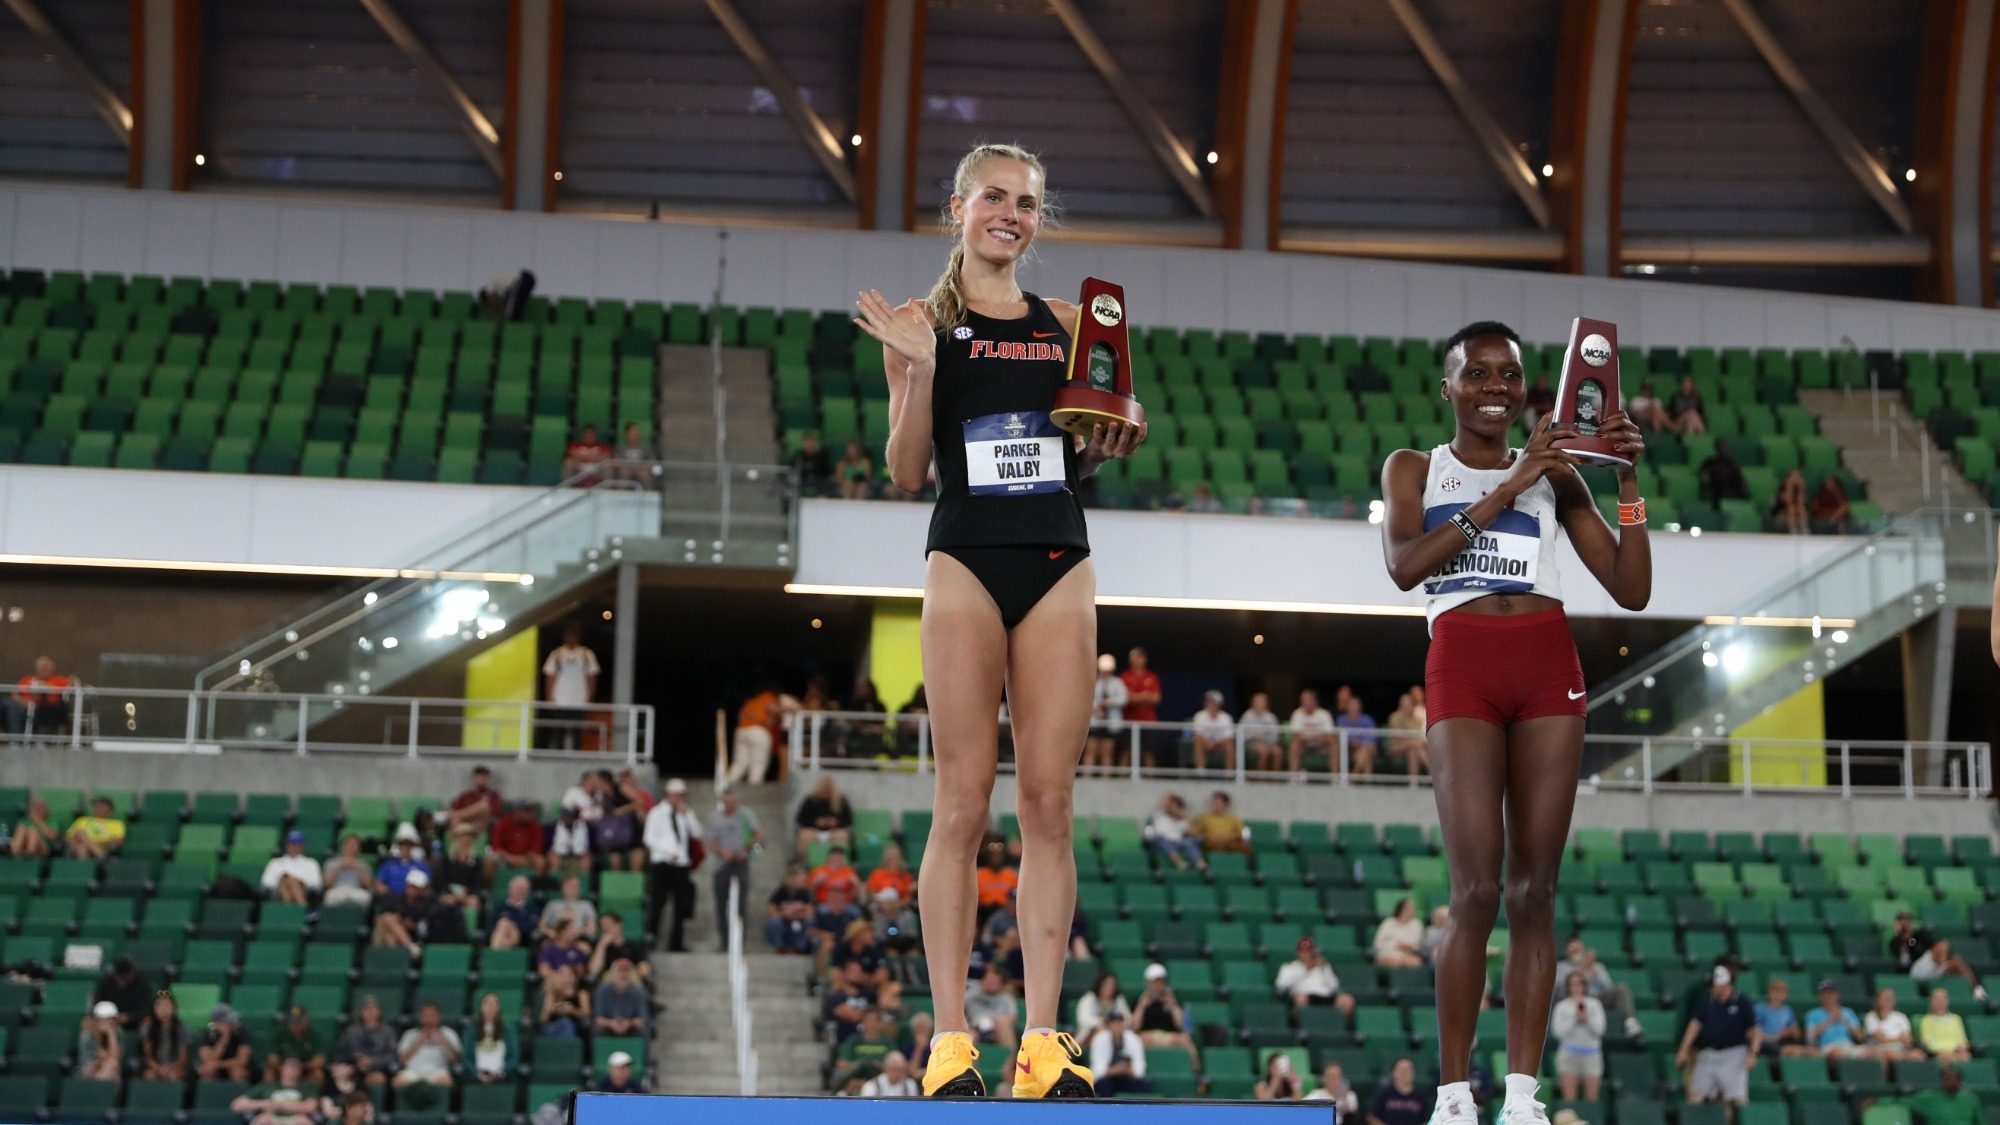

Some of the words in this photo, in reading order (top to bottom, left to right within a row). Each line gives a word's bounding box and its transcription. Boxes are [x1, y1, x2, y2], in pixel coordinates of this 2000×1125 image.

[1094, 305, 1120, 321] NCAA
[954, 326, 973, 339] SEC
[969, 340, 1065, 362] FLORIDA
[1584, 348, 1610, 359] NCAA
[994, 443, 1040, 458] PARKER
[996, 460, 1040, 479] VALBY
[1443, 477, 1461, 491] SEC
